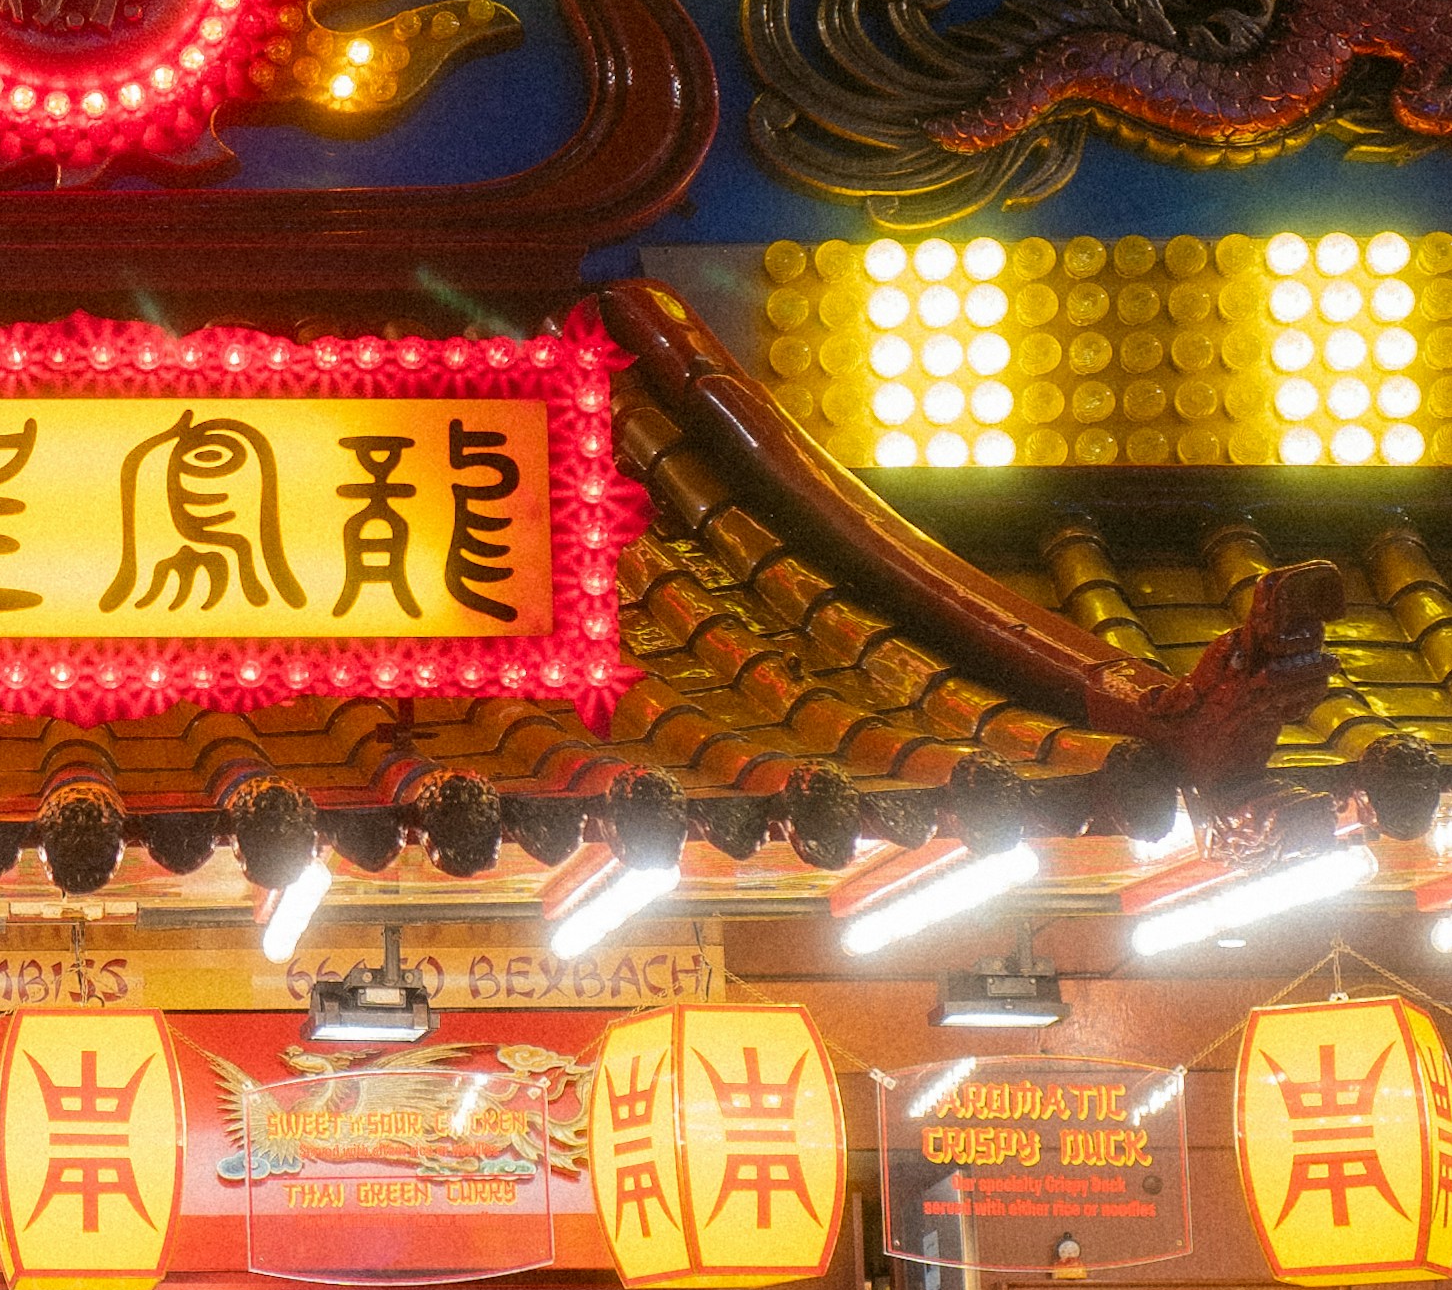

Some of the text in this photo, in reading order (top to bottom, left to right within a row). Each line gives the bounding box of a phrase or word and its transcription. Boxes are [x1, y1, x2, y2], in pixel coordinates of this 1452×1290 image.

[467, 954, 703, 1001] BEXBACH
[936, 1080, 1128, 1121] AROMATIC
[267, 1112, 347, 1140] SWEET
[366, 1111, 423, 1138] SOUR
[921, 1125, 1153, 1167] CRISPY DUCK
[283, 1181, 517, 1208] THAI GREEN CURRY
[973, 1198, 1006, 1216] with
